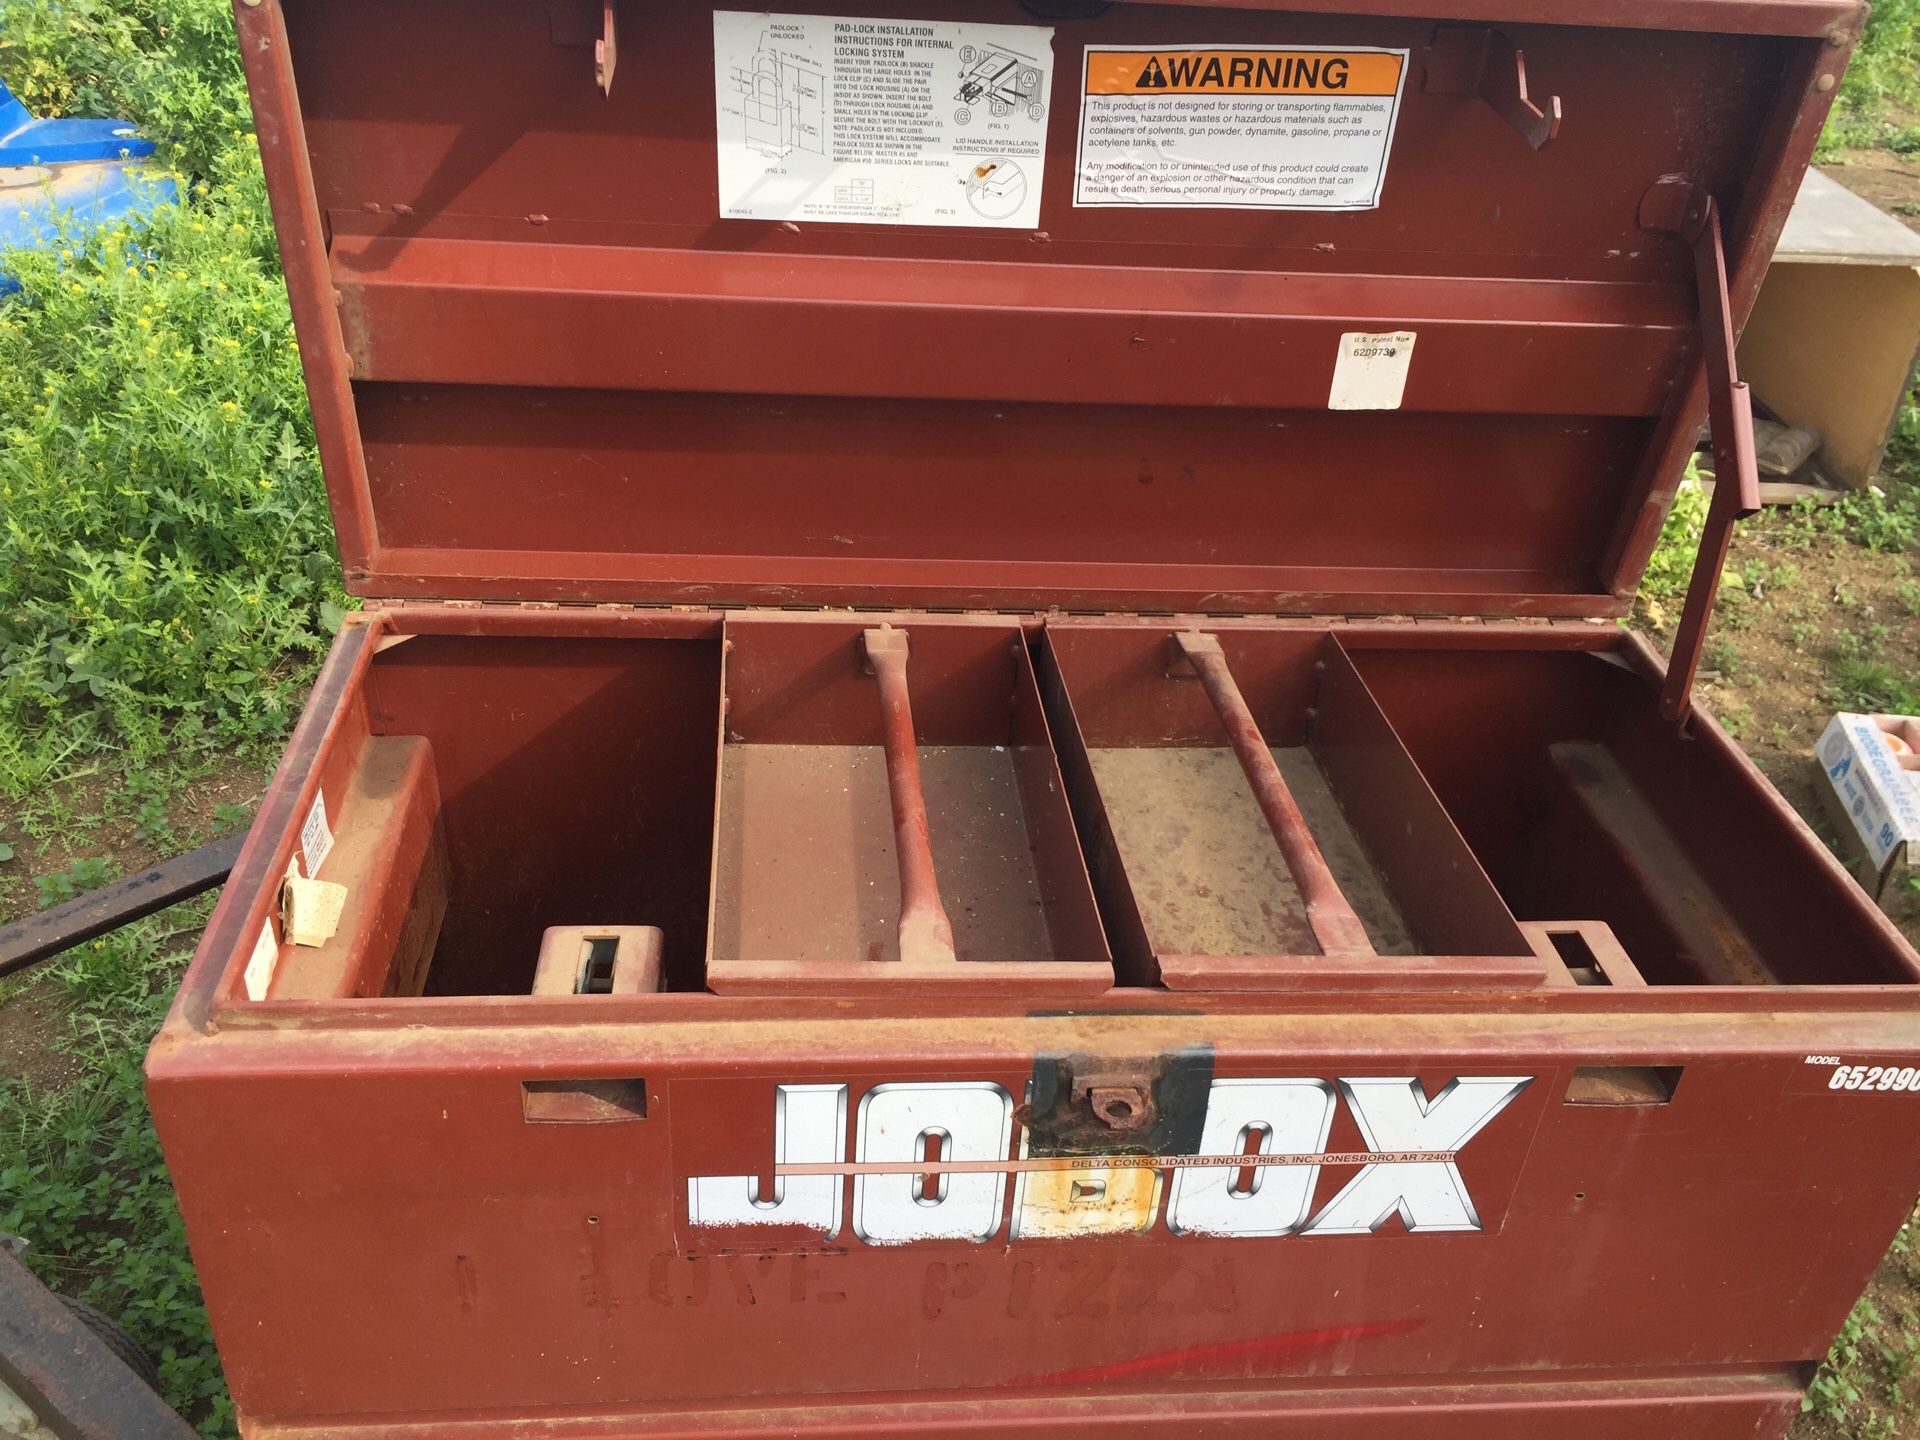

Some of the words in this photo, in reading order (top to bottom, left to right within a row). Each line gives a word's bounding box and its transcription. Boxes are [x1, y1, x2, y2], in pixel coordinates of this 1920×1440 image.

[835, 24, 875, 33] PAD-LOCK
[878, 26, 933, 36] INSTALLATION
[835, 36, 893, 46] INSTRUCTIONS
[897, 39, 912, 47] FOR
[915, 40, 953, 49] INTERNAL
[835, 48, 869, 56] LOCKING
[872, 50, 904, 58] SYSTEM
[1168, 57, 1349, 89] WARNING
[1093, 102, 1110, 110] This
[1113, 102, 1146, 113] product
[1175, 102, 1215, 113] designed
[1218, 102, 1230, 110] for
[1232, 103, 1262, 113] storing
[1277, 103, 1330, 113] transporting
[1333, 103, 1386, 113] flammables,
[1091, 114, 1138, 124] explosives,
[1141, 114, 1187, 123] hazardous
[1235, 115, 1281, 123] hazardous
[1285, 115, 1325, 123] materials
[1328, 116, 1348, 124] such
[1090, 126, 1134, 134] containers
[1138, 126, 1147, 134] of
[1150, 127, 1186, 136] solvents,
[1189, 129, 1205, 137] gun
[1208, 127, 1242, 137] powder,
[1246, 128, 1288, 137] dynamite,
[1292, 128, 1330, 137] gasoline,
[1089, 138, 1130, 149] acetylene
[1133, 138, 1158, 148] tanks,
[1087, 162, 1103, 172] Any
[1106, 162, 1157, 170] modification
[1280, 164, 1312, 174] product
[1094, 175, 1123, 185] danger
[1151, 174, 1190, 185] explosion
[1230, 175, 1274, 184] hazardous
[1277, 176, 1316, 184] condition
[1319, 176, 1335, 184] that
[1121, 186, 1147, 194] death,
[1184, 186, 1220, 196] personal
[1223, 186, 1246, 197] injury
[1261, 188, 1296, 197] property
[1299, 188, 1336, 197] damage.
[1353, 348, 1396, 357] 6209739
[1804, 1056, 1841, 1065] MODEL
[1072, 1160, 1110, 1168] DELTA
[1114, 1157, 1209, 1167] CONSOLIDATED
[1213, 1156, 1288, 1165] INDUSTRIES,
[1292, 1155, 1315, 1164] INC.
[1319, 1154, 1397, 1164] JONESBORO,
[1400, 1153, 1417, 1161] AR
[1421, 1153, 1453, 1161] 72401
